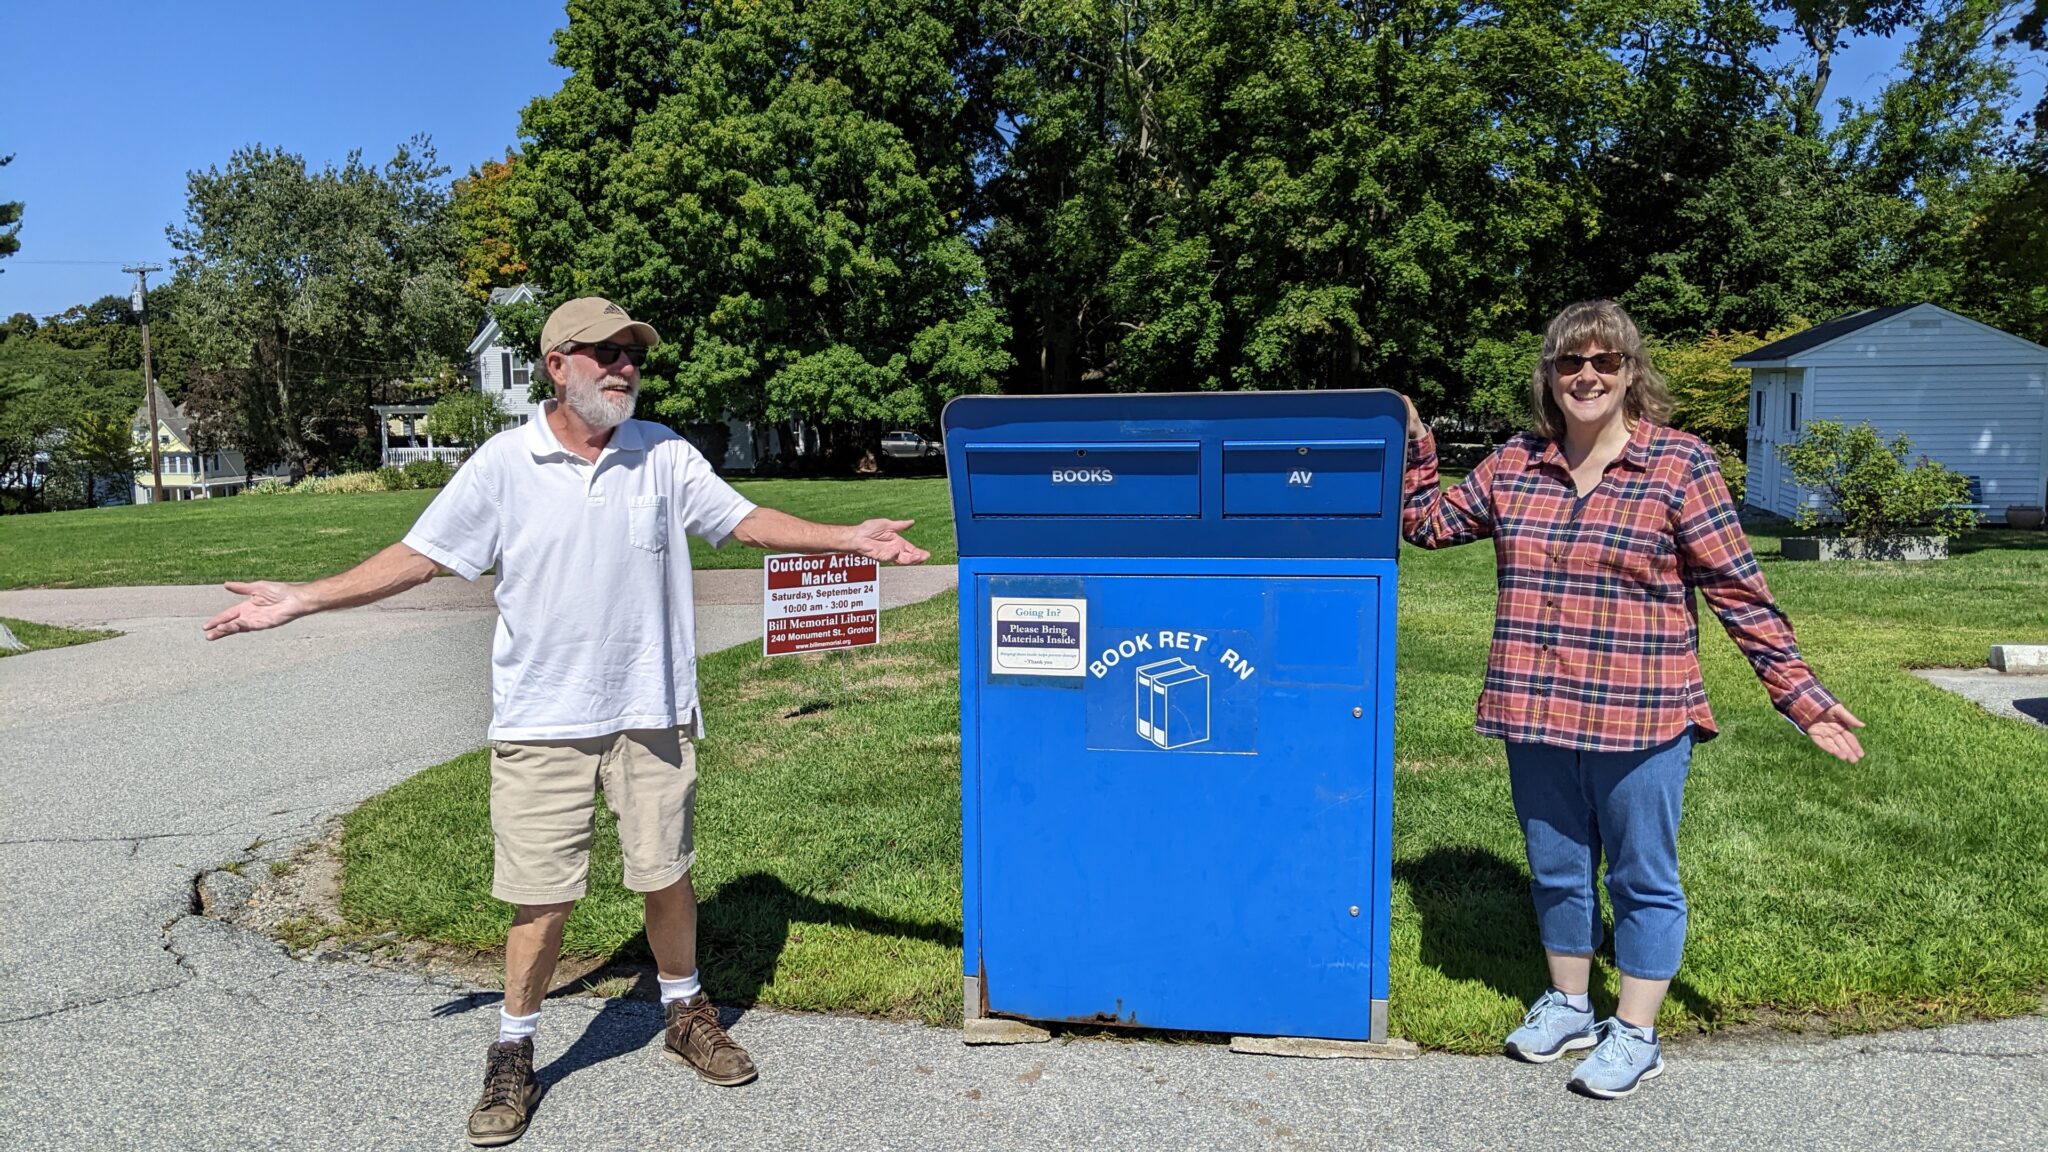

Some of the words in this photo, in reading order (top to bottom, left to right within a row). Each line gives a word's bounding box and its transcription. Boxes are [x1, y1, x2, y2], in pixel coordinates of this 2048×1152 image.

[1052, 469, 1113, 482] BOOKS
[1289, 471, 1312, 484] AV
[770, 558, 825, 573] Outdoor
[801, 570, 848, 585] Market
[771, 591, 813, 602] Saturday,
[816, 587, 861, 599] September
[863, 585, 874, 593] 24
[783, 604, 807, 613] 10:00
[830, 600, 848, 609] 3:00
[850, 600, 864, 608] pm
[1015, 608, 1043, 619] Going
[1047, 609, 1061, 617] In?
[769, 619, 787, 631] Bill
[790, 615, 838, 629] Memorial
[841, 613, 876, 624] Library
[771, 634, 786, 643] 240
[788, 630, 831, 641] Monument
[847, 626, 874, 635] Groton
[1010, 624, 1039, 634] Please
[1042, 625, 1068, 636] Bring
[1001, 635, 1045, 644] Materials
[1047, 635, 1076, 645] Inside
[1089, 633, 1153, 679] BOOK
[1159, 631, 1255, 681] RETRN
